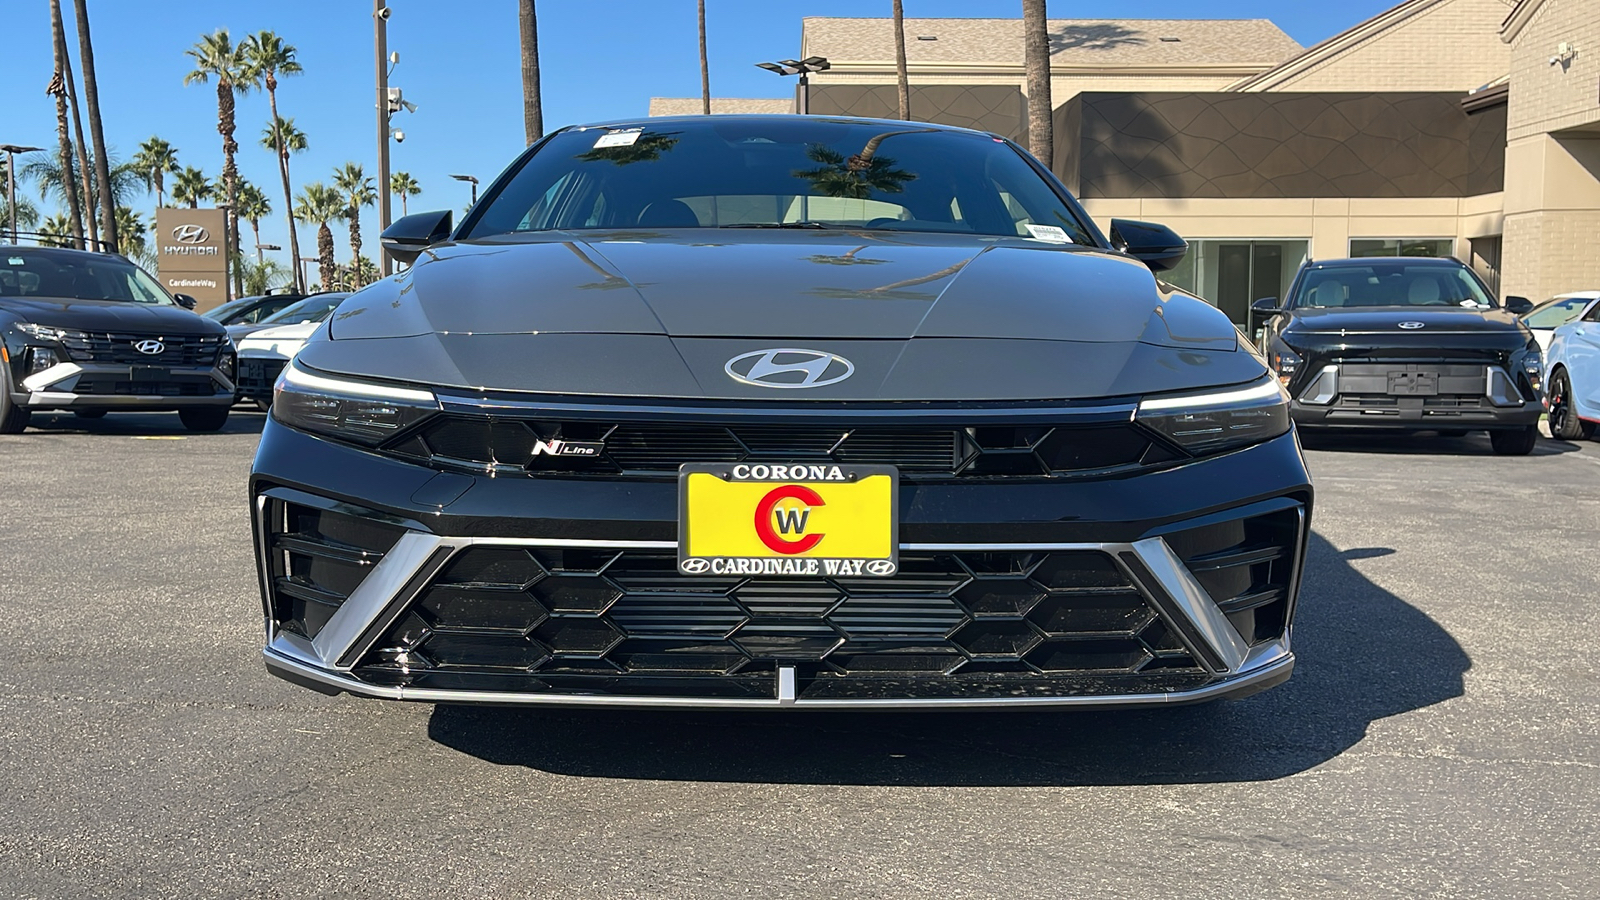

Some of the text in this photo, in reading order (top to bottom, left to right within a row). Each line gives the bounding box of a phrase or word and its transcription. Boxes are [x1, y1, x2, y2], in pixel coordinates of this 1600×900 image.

[164, 246, 218, 255] HYUNDAI
[169, 279, 216, 288] CardinaleWay
[531, 440, 562, 456] N
[733, 465, 845, 480] CORONA
[754, 484, 826, 555] C
[775, 507, 811, 534] W
[711, 558, 866, 576] CARDINALE WAY
